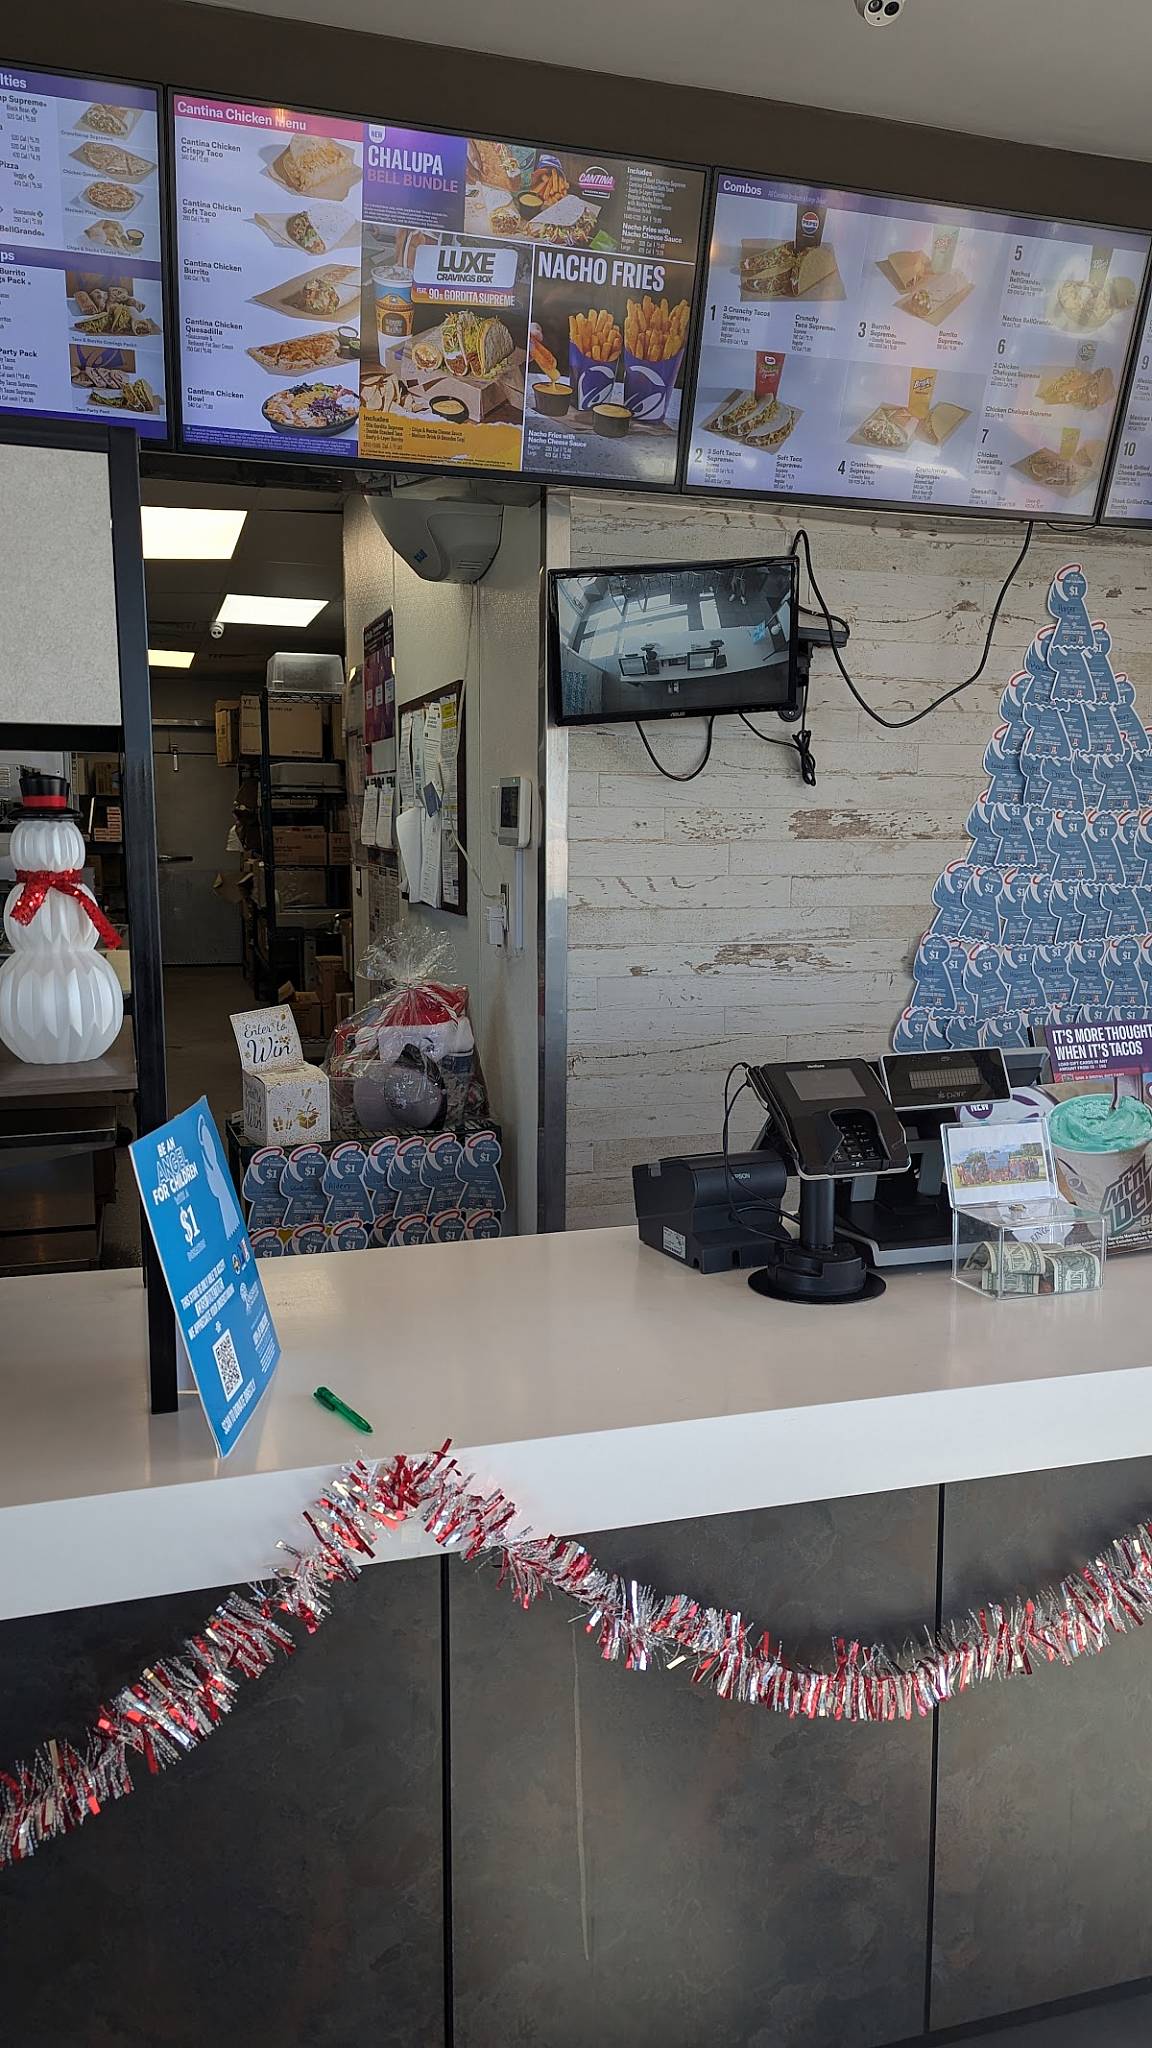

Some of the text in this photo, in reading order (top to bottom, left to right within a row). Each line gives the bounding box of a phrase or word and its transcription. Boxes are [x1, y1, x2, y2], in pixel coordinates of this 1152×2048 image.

[177, 102, 306, 131] Cantina Chicken Menu
[181, 138, 241, 154] Cantina Chicken
[182, 146, 206, 158] Crispy
[206, 150, 224, 158] Taco
[368, 145, 444, 176] CHALUPA
[628, 167, 652, 176] Includes
[368, 168, 458, 194] BELL BUNDLE
[579, 173, 614, 185] CANTINA
[722, 180, 762, 196] Combos
[182, 199, 242, 214] Cantina Chicken
[182, 207, 216, 218] Soft Taco
[622, 222, 642, 231] Nacho
[622, 230, 682, 244] Nacho Cheese Sauce
[1014, 245, 1023, 261] 5
[184, 258, 242, 273] Cantina Chicken
[437, 250, 496, 274] LUXE
[184, 266, 209, 276] Burrito
[538, 252, 665, 293] NACHO FRIES
[436, 274, 494, 284] CRAVINGS BOX
[444, 290, 478, 303] GORDITA
[479, 293, 516, 307] SUPREME
[710, 304, 716, 321] 1
[729, 306, 753, 316] Crunchy
[754, 309, 770, 318] Tacos
[796, 314, 820, 322] Crunchy
[186, 318, 242, 331] Cantina Chicken
[858, 322, 866, 338] 3
[186, 326, 222, 336] Quesadilla
[998, 338, 1006, 354] 6
[1141, 355, 1150, 370] 9
[188, 388, 244, 400] Cantina Chicken
[188, 395, 204, 404] Bowl
[986, 406, 1007, 414] Chicken
[529, 430, 547, 439] Nacho
[982, 429, 989, 444] 7
[528, 437, 546, 446] Nacho
[1124, 442, 1136, 456] 10
[694, 448, 702, 464] 2
[838, 460, 846, 475] 4
[1069, 586, 1079, 597] $1
[1012, 806, 1021, 816] $1
[1034, 816, 1046, 826] $1
[1068, 822, 1079, 833] $1
[1098, 827, 1109, 837] $1
[984, 883, 994, 894] $1
[929, 950, 940, 960] $1
[1018, 952, 1028, 963] $1
[1086, 950, 1097, 960] $1
[1122, 950, 1132, 961] $1
[949, 960, 960, 970] $1
[982, 962, 992, 972] $1
[1094, 1010, 1104, 1020] $1
[1126, 1010, 1137, 1020] $1
[1002, 1020, 1013, 1030] $1
[1034, 1016, 1044, 1026] $1
[243, 1022, 288, 1039] Enter to
[914, 1023, 924, 1033] $1
[1052, 1029, 1072, 1046] IT'S
[1074, 1026, 1105, 1044] MORE
[246, 1036, 294, 1064] Win
[1054, 1041, 1143, 1062] WHEN IT'S TACOS
[157, 1137, 176, 1160] BE AN
[443, 1156, 454, 1165] $1
[480, 1152, 490, 1162] $1
[266, 1168, 278, 1180] $1
[304, 1166, 316, 1177] $1
[344, 1163, 356, 1174] $1
[152, 1162, 199, 1206] FOR CHILDREN
[180, 1204, 201, 1246] $1
[445, 1231, 456, 1240] $1
[306, 1244, 318, 1254] $1
[344, 1240, 356, 1250] $1
[262, 1250, 273, 1258] $1
